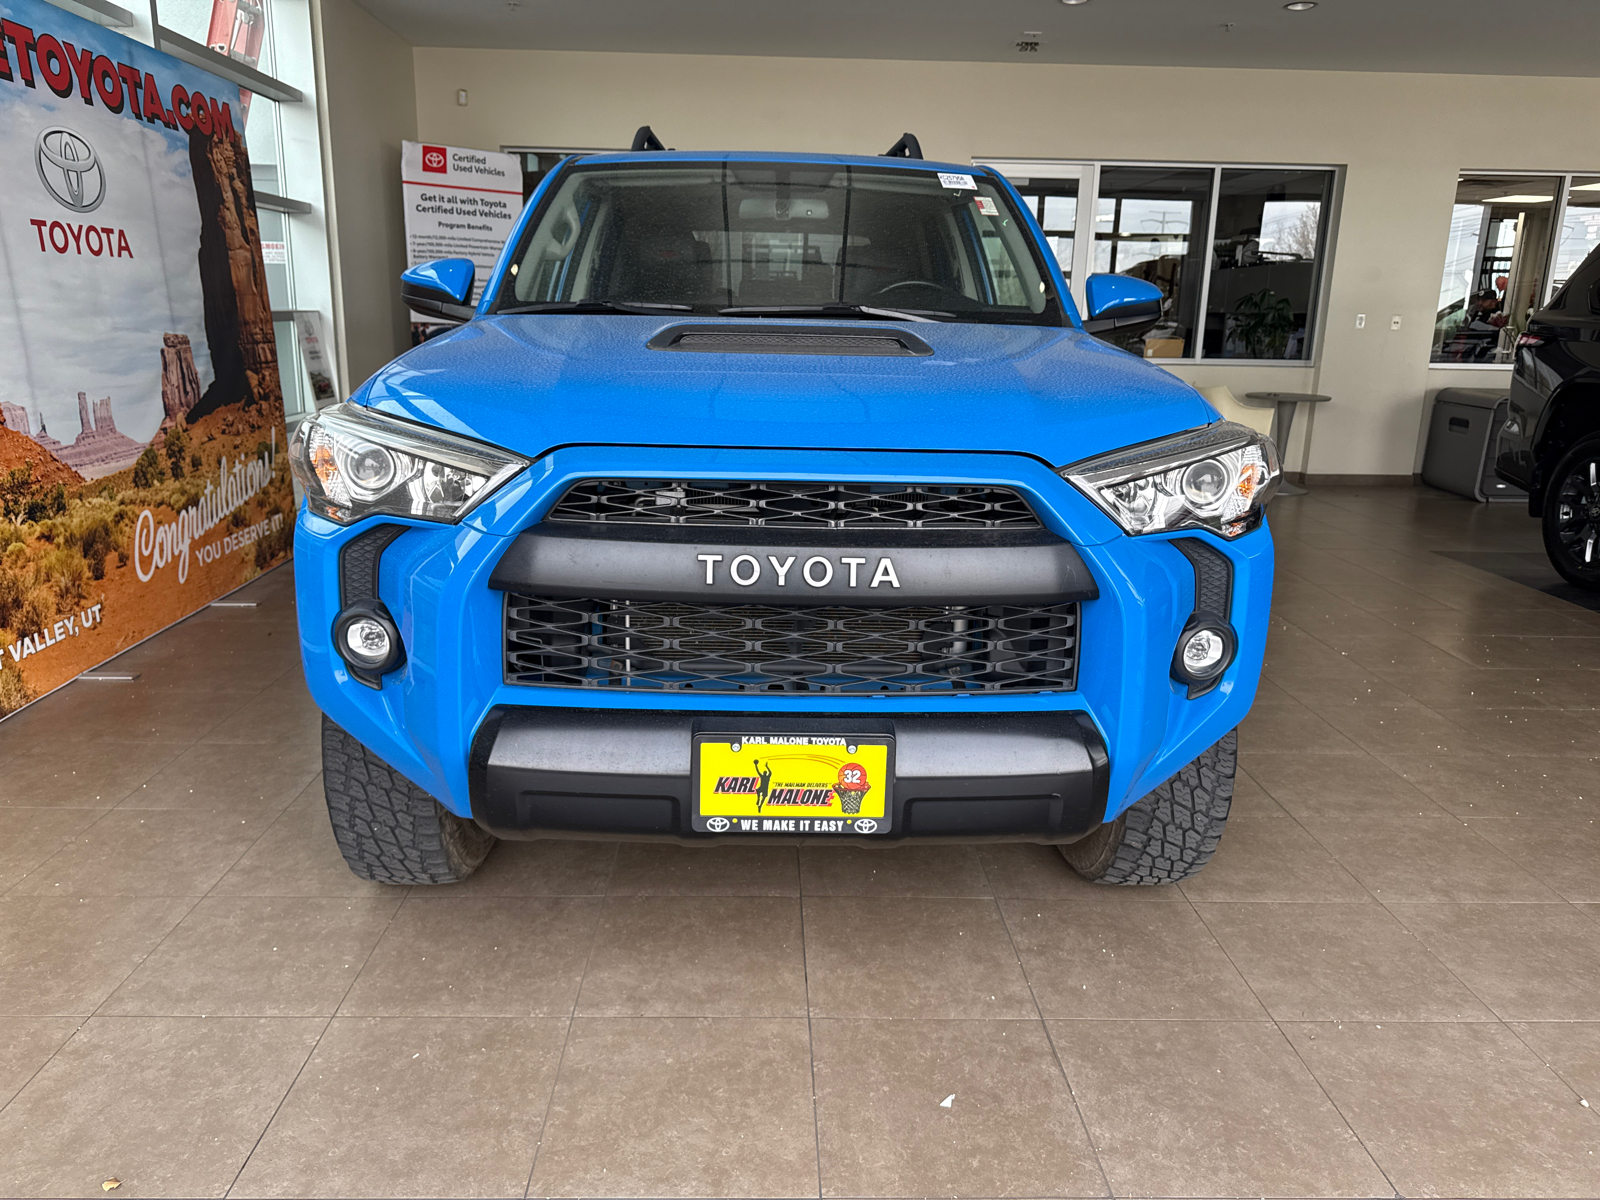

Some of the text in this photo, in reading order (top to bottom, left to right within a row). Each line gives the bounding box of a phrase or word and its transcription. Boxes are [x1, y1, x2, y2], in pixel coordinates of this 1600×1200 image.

[452, 153, 486, 165] Certified
[453, 164, 505, 177] Used Vehicles
[420, 193, 507, 209] Get it all with Toyota
[416, 204, 512, 220] Certified Used Vehicles
[438, 221, 493, 231] Program Benefits
[30, 218, 134, 259] TOYOTA
[134, 426, 276, 584] Congratulations!
[195, 513, 284, 566] YOU DESERVE IT!
[697, 554, 900, 588] TOYOTA
[8, 616, 79, 662] VALLEY,
[81, 604, 101, 628] UT
[741, 736, 847, 746] KARL MALONE TOYOTA
[843, 769, 862, 784] 32
[713, 776, 760, 794] KARL
[766, 788, 835, 807] MALONE
[740, 819, 844, 832] WE MAKE IT EASY
